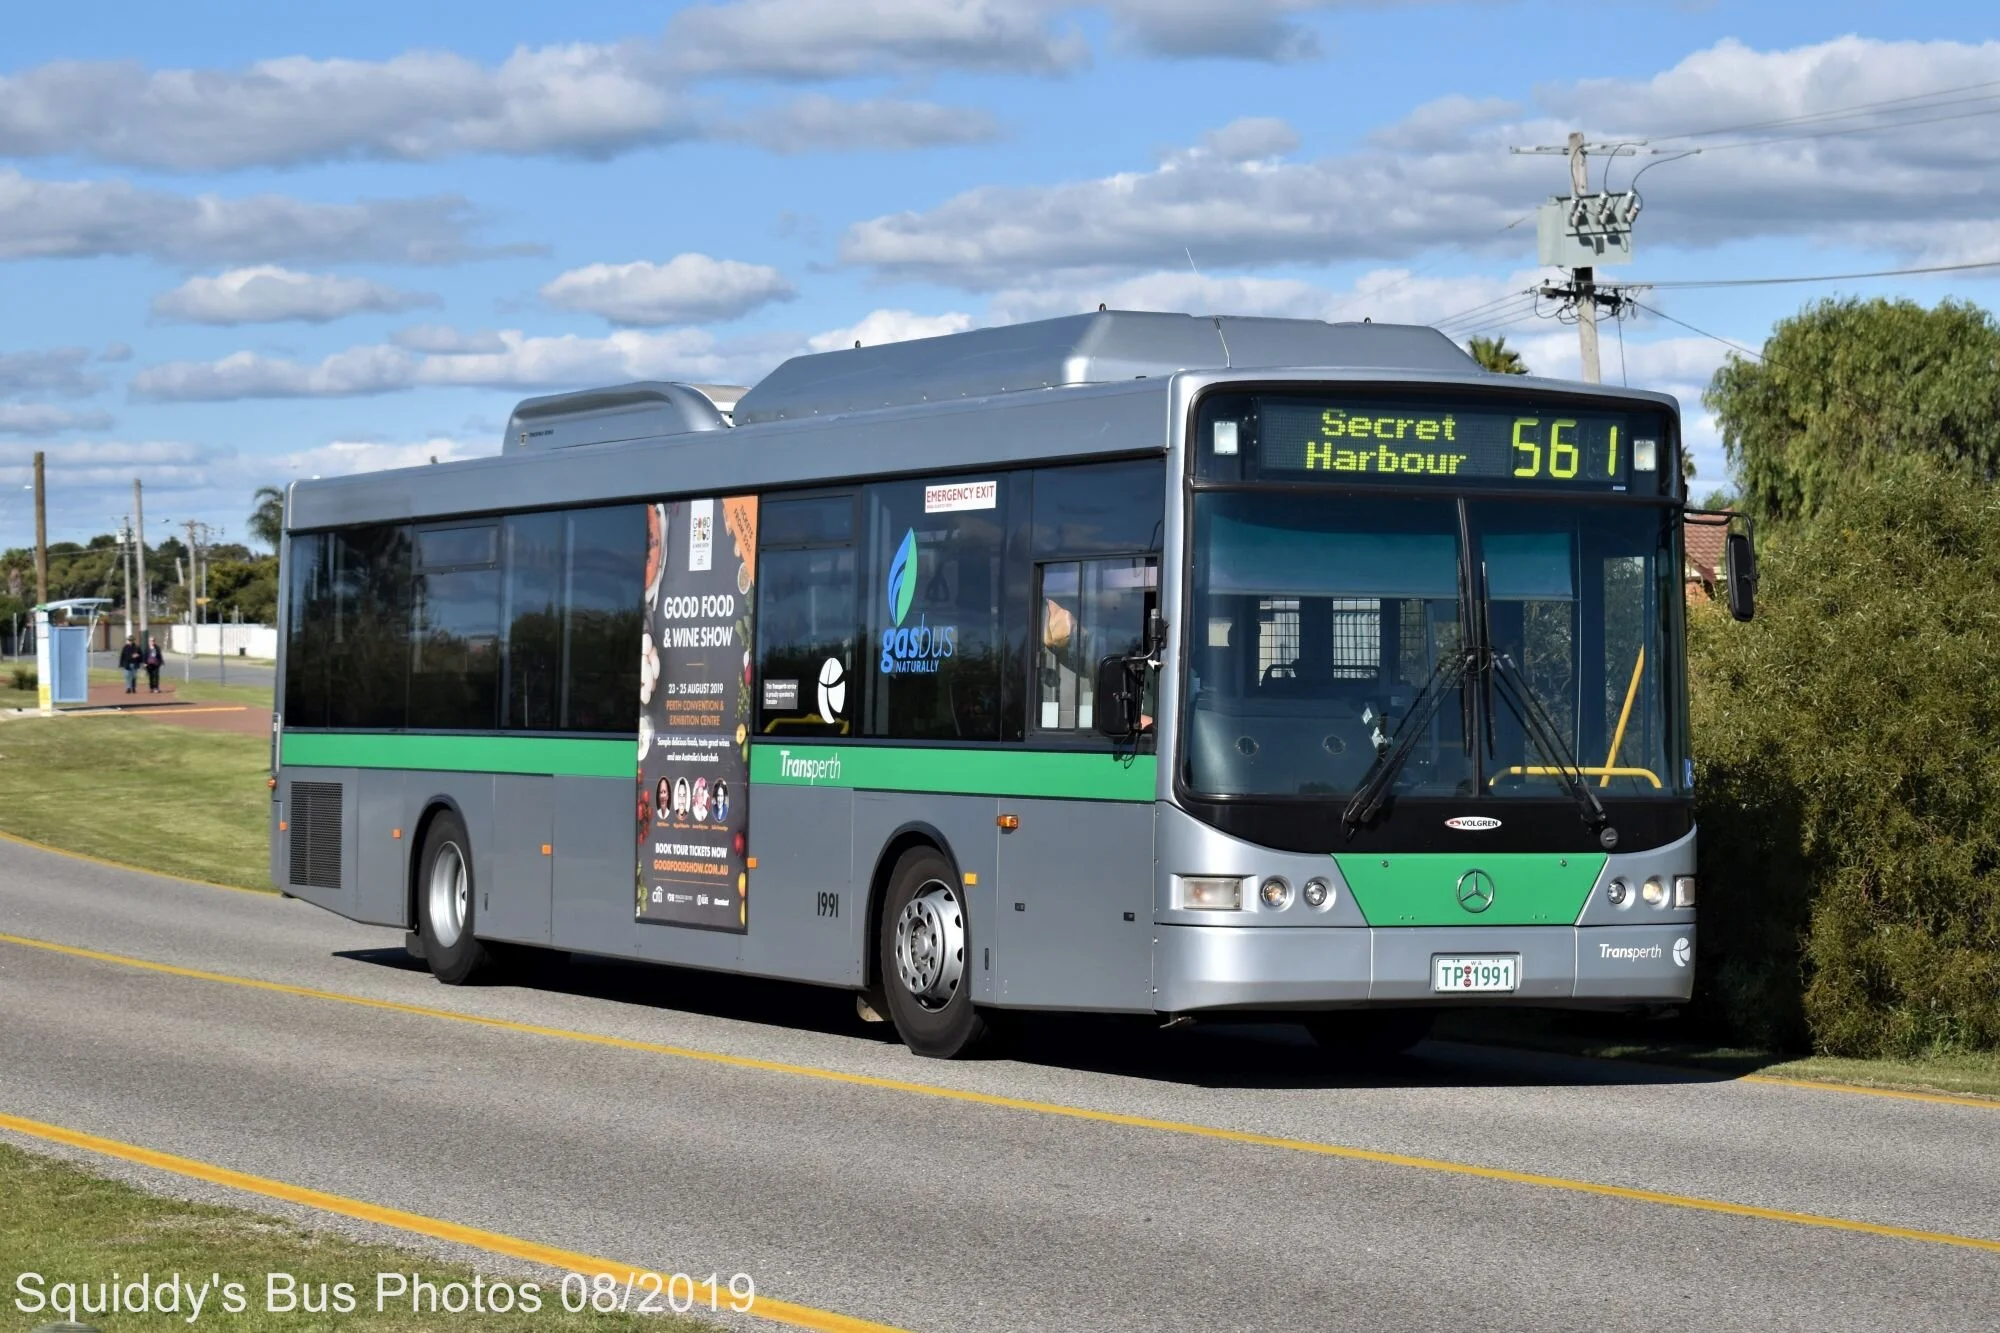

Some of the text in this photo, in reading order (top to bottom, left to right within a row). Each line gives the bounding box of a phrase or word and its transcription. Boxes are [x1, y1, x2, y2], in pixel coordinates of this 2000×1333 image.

[1322, 409, 1618, 478] Secret 561
[1306, 441, 1467, 474] Harbour
[926, 485, 994, 503] EMERGENCY EXIT
[664, 594, 734, 619] GOOD FOOD
[664, 626, 734, 648] & WINE SHOW
[881, 613, 954, 673] gasbus
[896, 660, 940, 672] NATURALLY
[668, 684, 676, 694] 23
[680, 684, 687, 694] 25
[688, 683, 710, 694] AUGUST
[710, 683, 724, 694] 2019
[666, 700, 682, 710] PERTH
[683, 700, 720, 710] CONVENTION
[670, 714, 720, 726] EXHIBITION CENTRE
[780, 750, 841, 786] Transperth
[655, 842, 727, 858] BOOK YOUR TICKETS NOW
[654, 860, 729, 876] GOODFOODSHOW.COM.AU
[817, 891, 839, 918] 1991
[1599, 943, 1662, 962] Transperth
[1442, 966, 1509, 986] TP 1991
